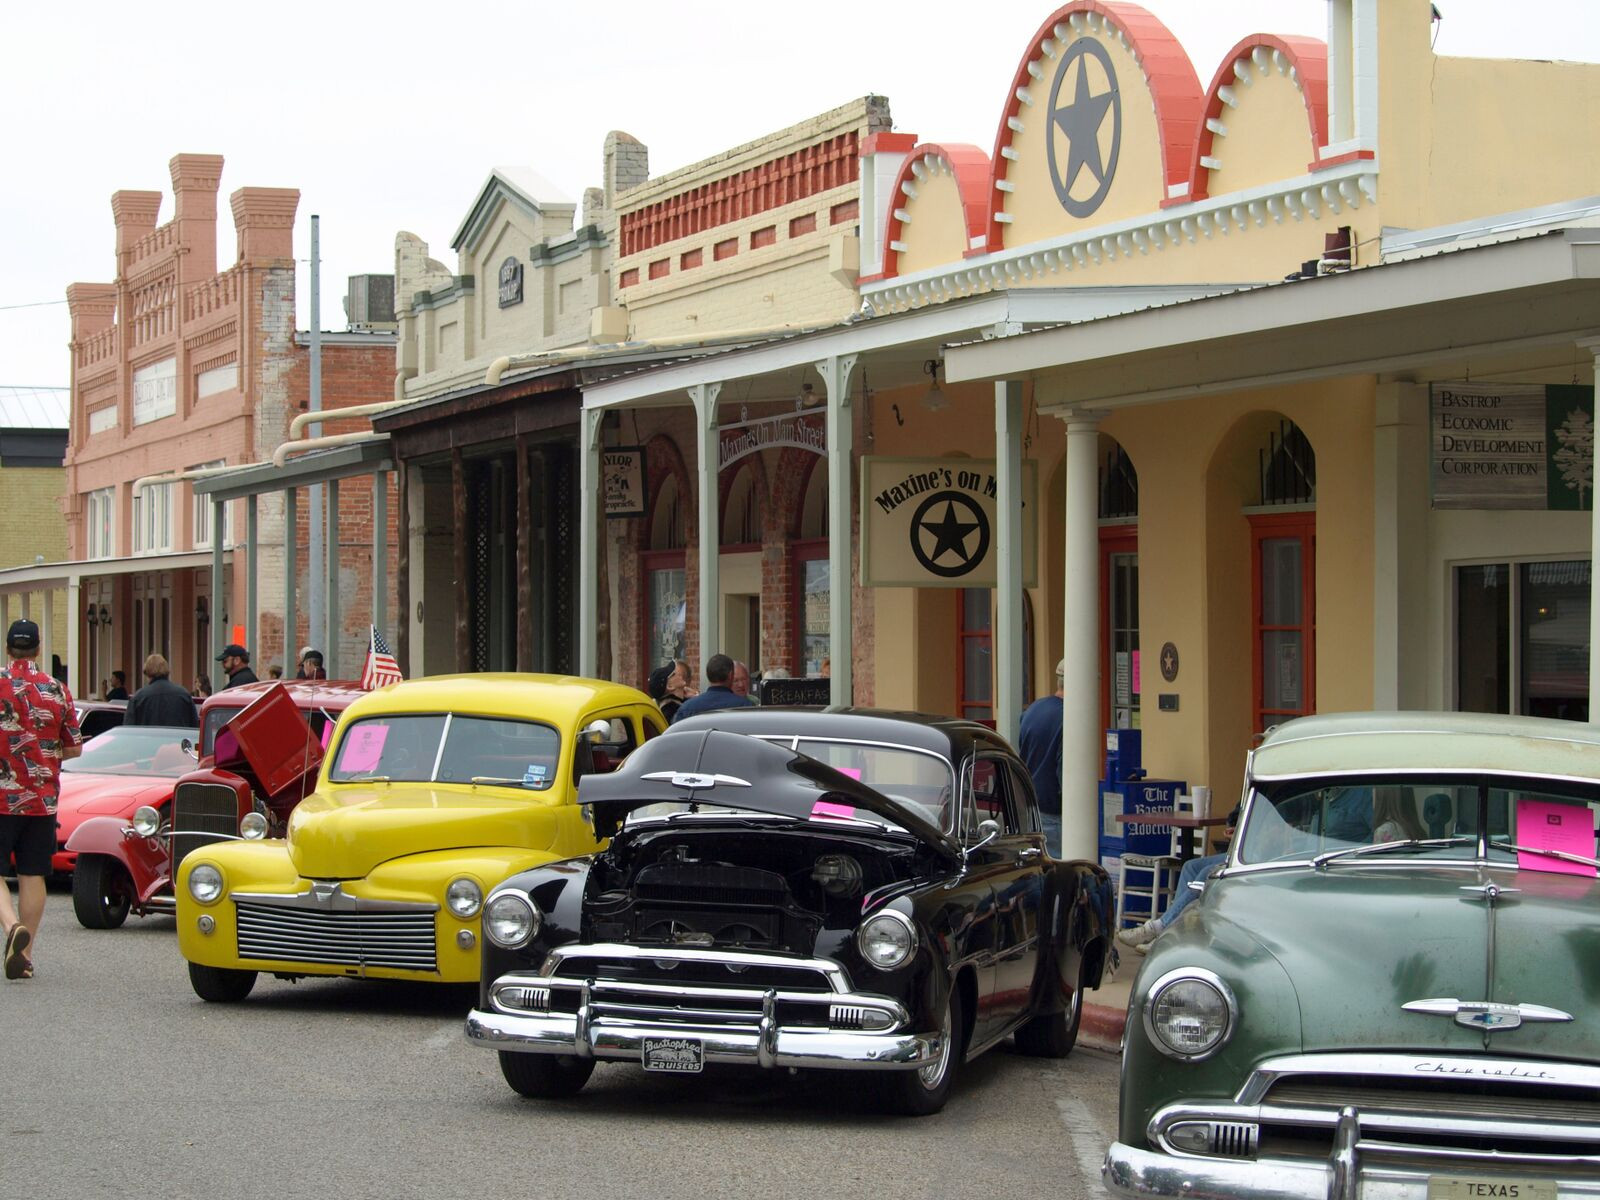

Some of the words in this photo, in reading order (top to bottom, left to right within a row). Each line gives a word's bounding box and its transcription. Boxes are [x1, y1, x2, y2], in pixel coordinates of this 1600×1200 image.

[1441, 391, 1502, 408] BASTROP
[1441, 413, 1513, 431] ECONOMIC
[796, 418, 825, 450] Street
[1442, 435, 1544, 453] DEVELOPMENT
[1441, 458, 1538, 475] CORPORATION
[875, 468, 952, 514] Maxine's
[958, 470, 981, 491] on
[771, 688, 830, 704] BREAKFAS
[1143, 787, 1169, 802] The
[1134, 804, 1173, 815] Bastro
[648, 1061, 700, 1070] CRUISERS
[1414, 1062, 1556, 1079] Chevrolet
[1467, 1183, 1519, 1198] TEXAS
